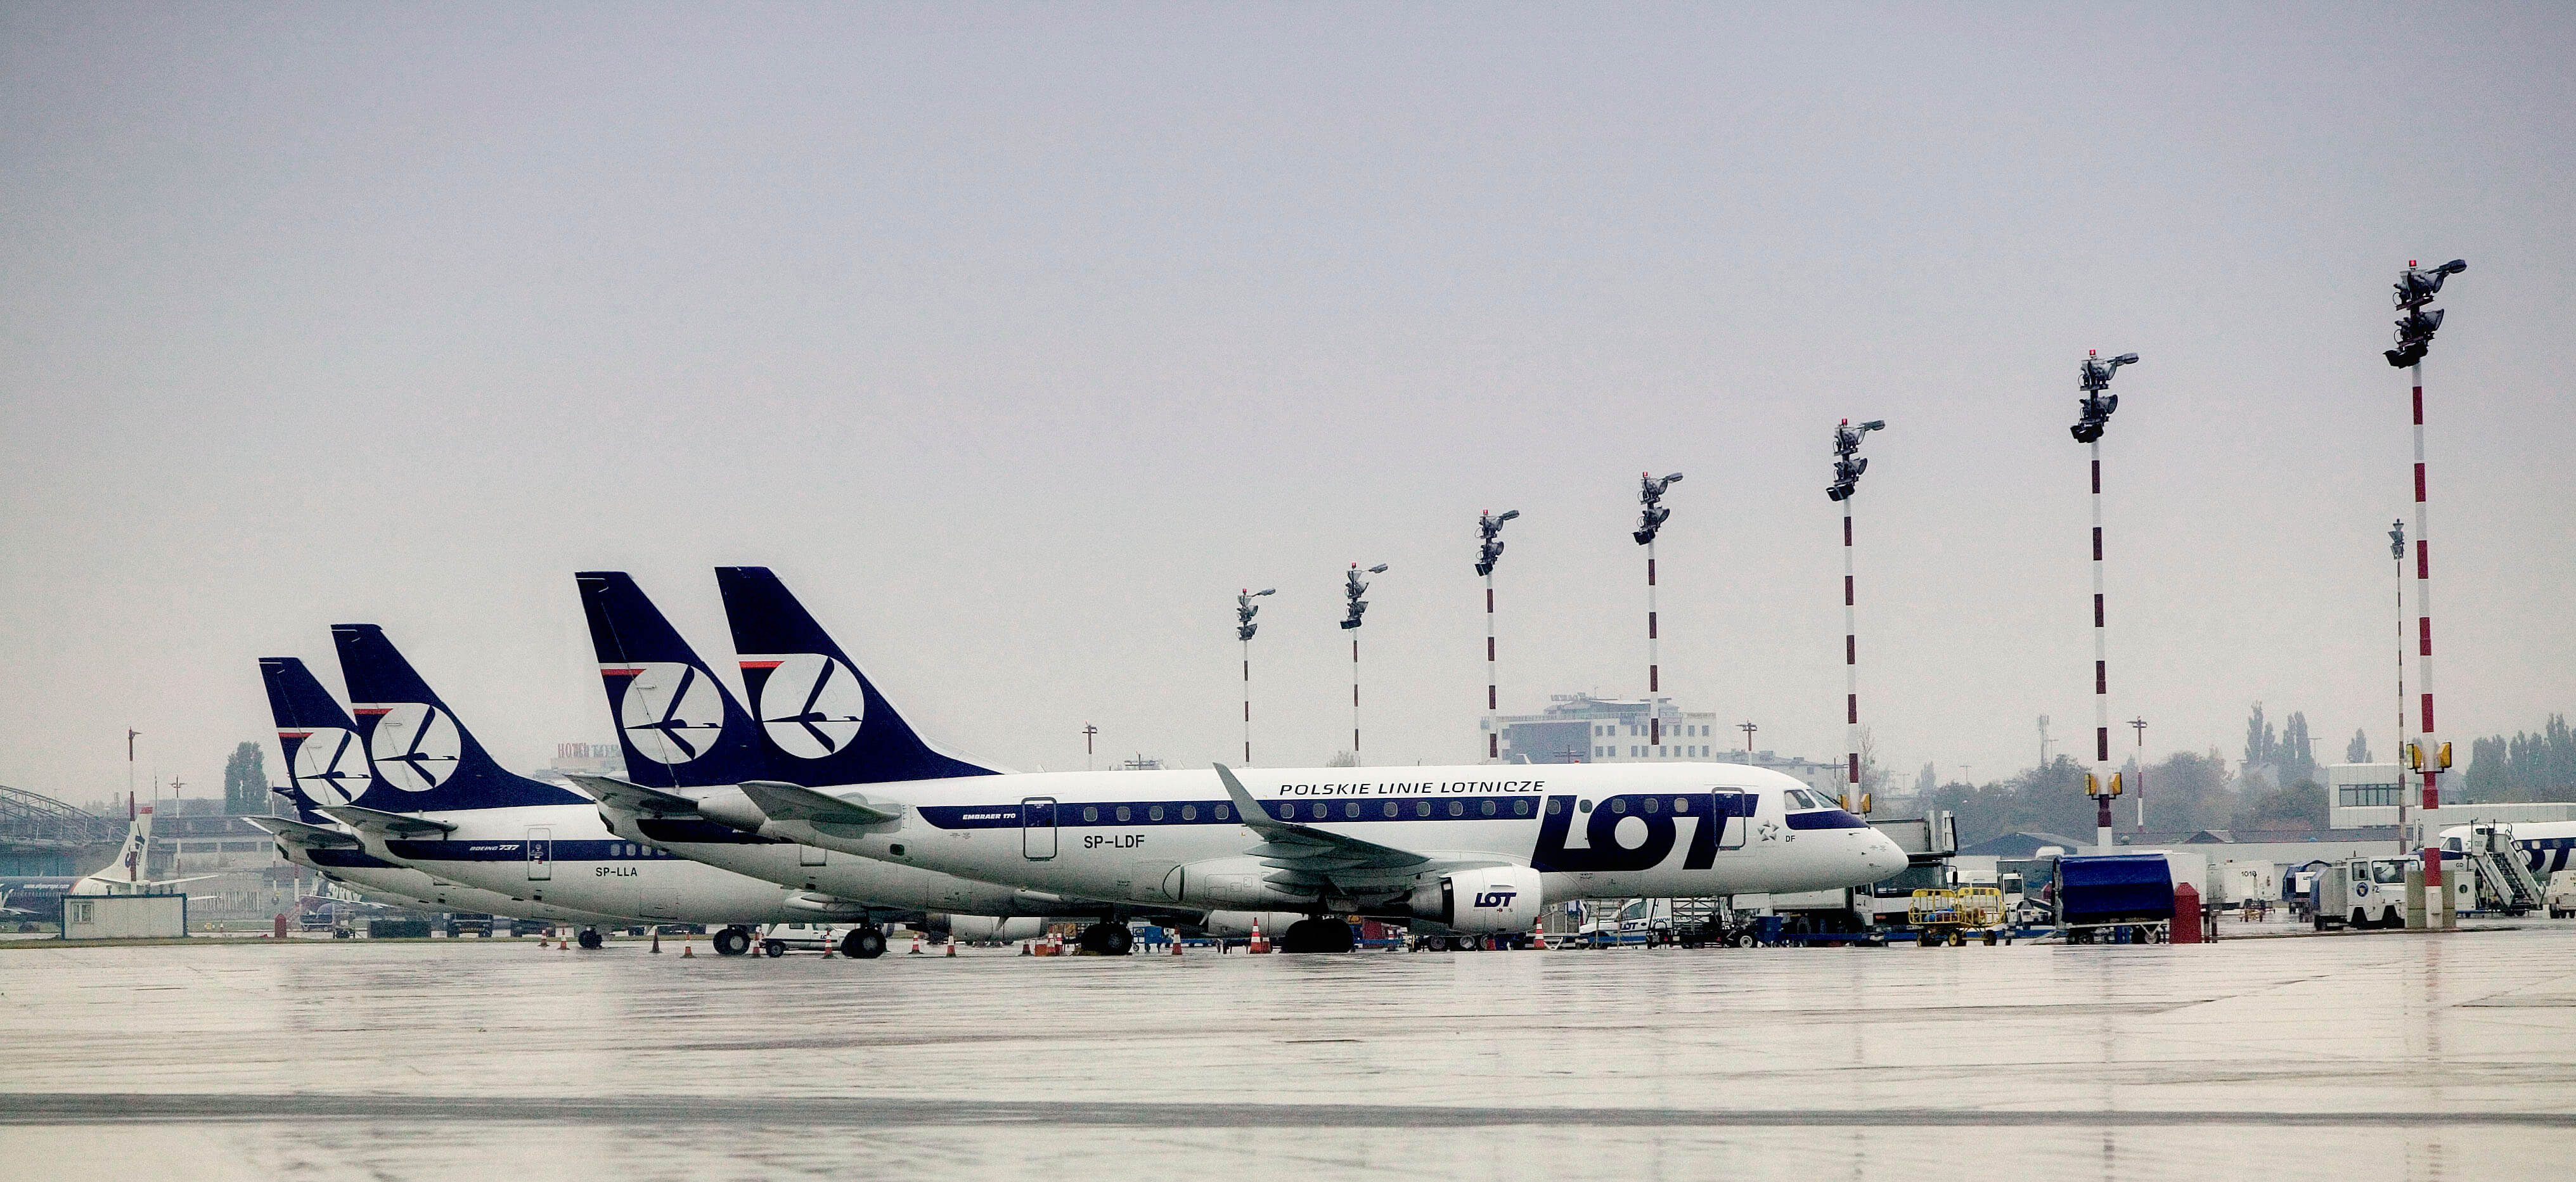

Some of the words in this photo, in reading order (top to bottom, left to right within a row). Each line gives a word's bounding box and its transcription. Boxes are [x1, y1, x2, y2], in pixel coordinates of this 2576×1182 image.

[1279, 783, 1371, 795] POLSKIE
[1378, 782, 1433, 794] LINIE
[1440, 781, 1545, 793] LOTNICZE
[1530, 793, 1760, 873] LOT
[1083, 835, 1145, 849] SP-LDF
[595, 867, 638, 877] SP-LLA
[1473, 892, 1517, 908] LOT
